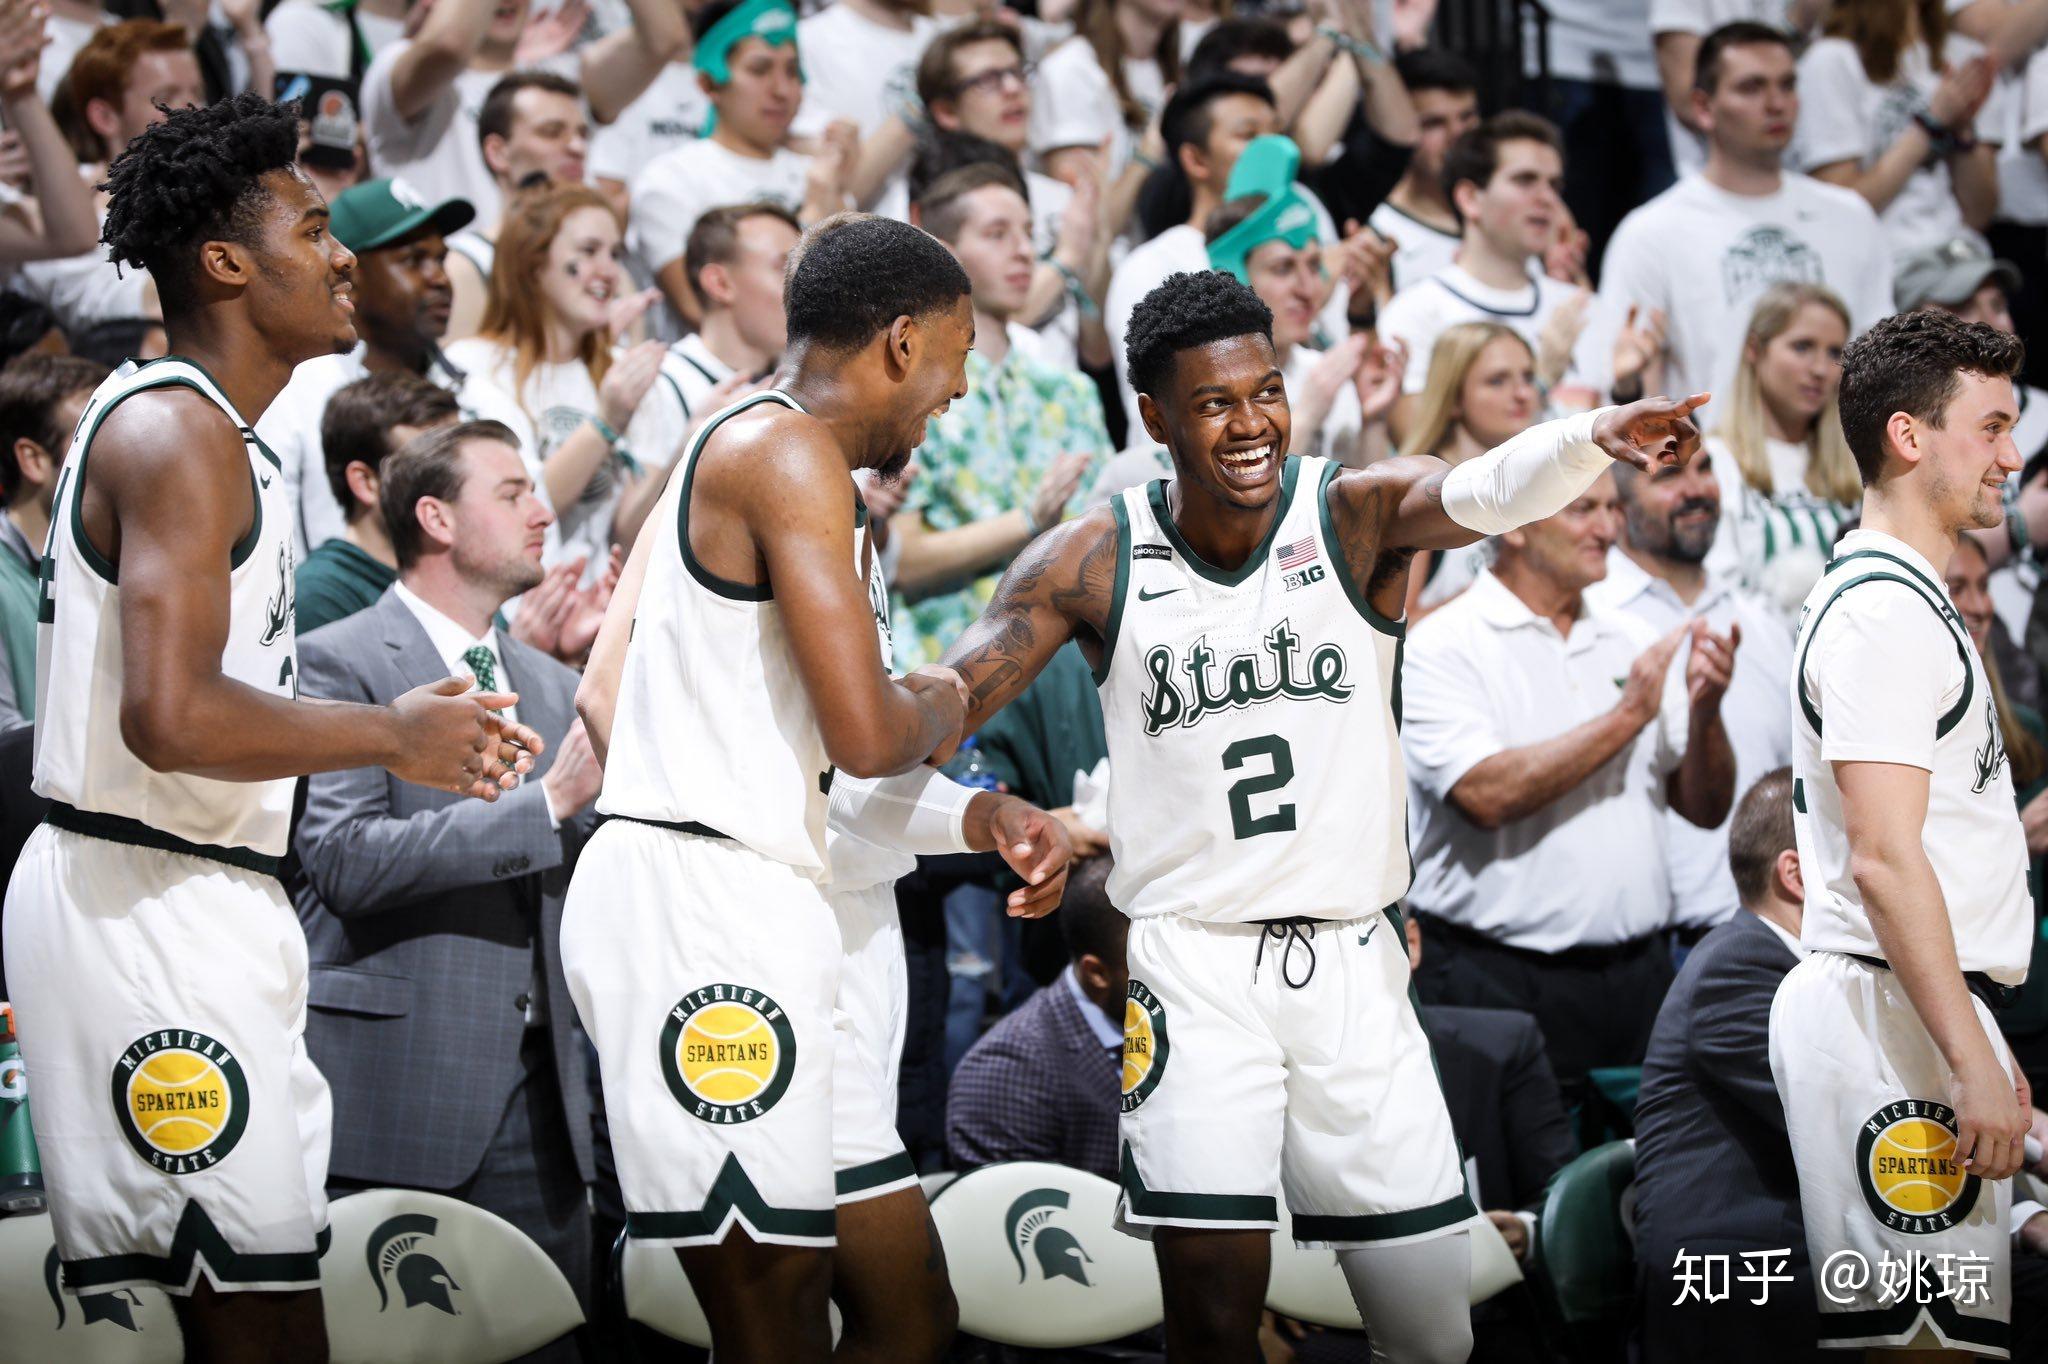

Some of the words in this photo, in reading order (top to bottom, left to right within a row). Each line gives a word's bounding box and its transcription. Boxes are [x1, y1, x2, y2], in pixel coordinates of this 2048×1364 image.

[1141, 616, 1356, 737] State
[1221, 733, 1297, 840] 2
[671, 985, 783, 1022] MICHIGAN
[120, 1031, 232, 1070] MICHIGAN
[687, 1043, 768, 1063] SPARTANS
[137, 1089, 219, 1112] SPARTANS
[695, 1099, 764, 1123] STATE
[1866, 1101, 1957, 1135] MICHIGA
[151, 1149, 218, 1173] STATE
[1878, 1156, 1958, 1176] SPARTANS
[1886, 1212, 1953, 1232] STATE
